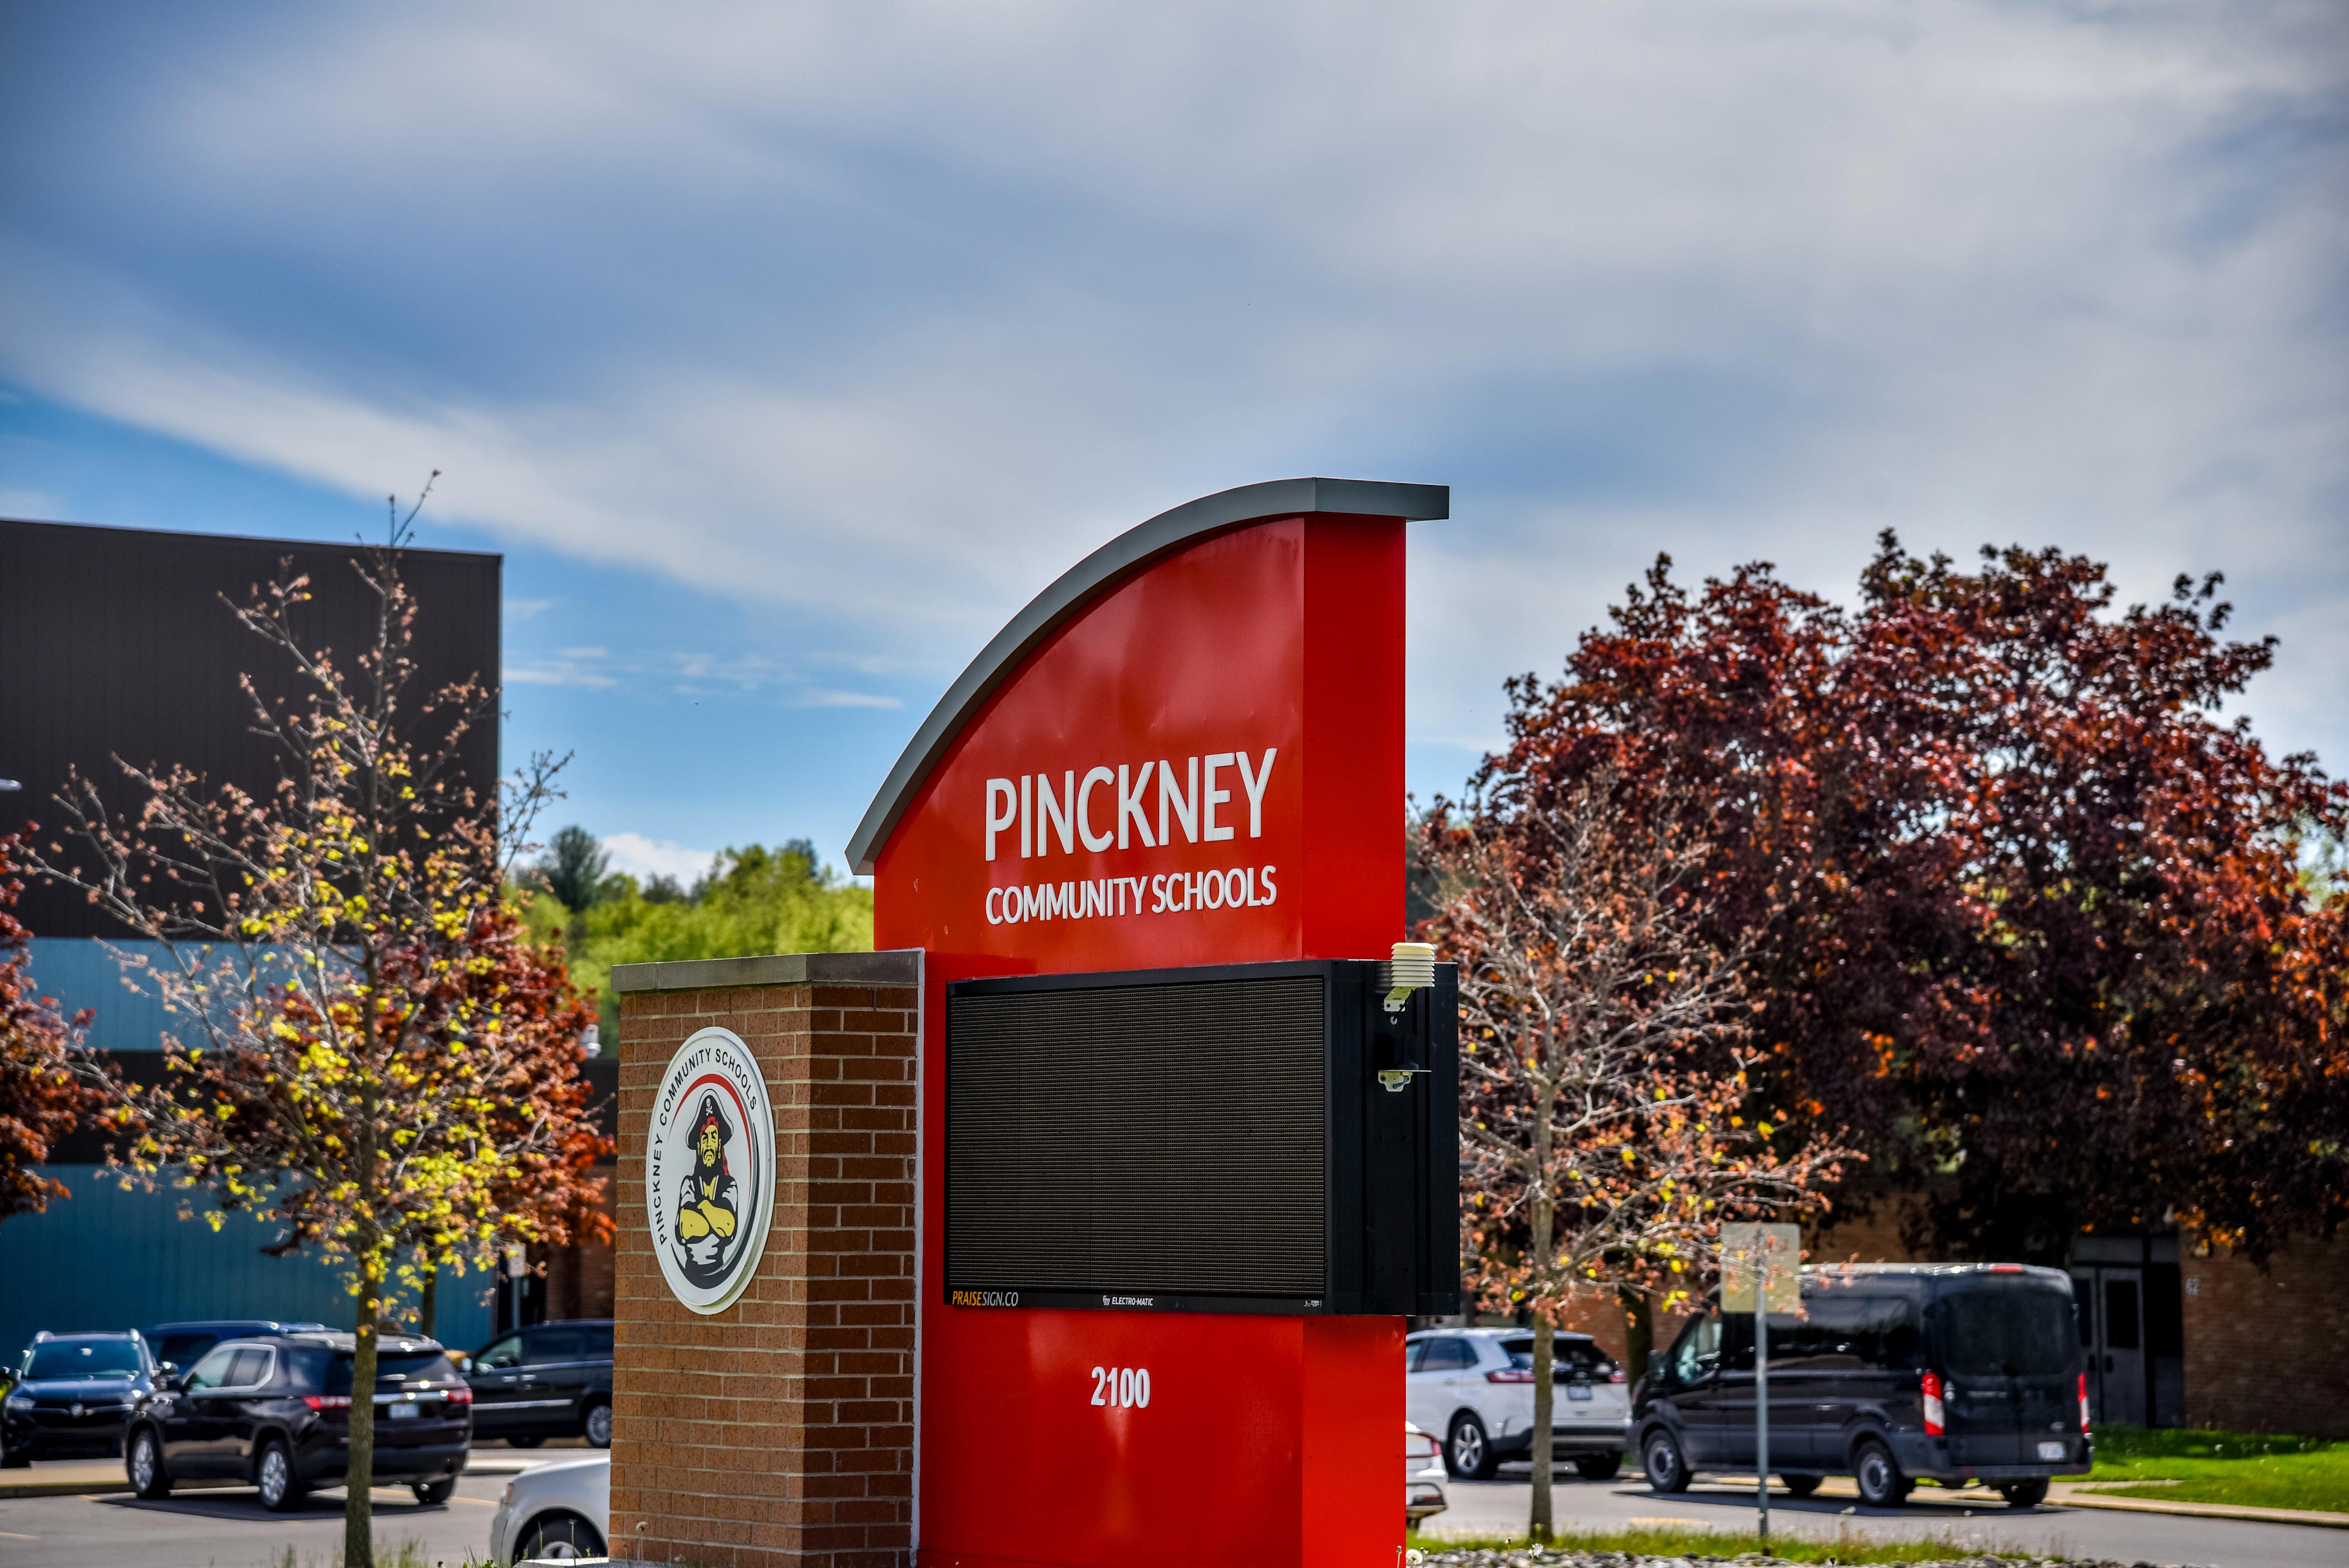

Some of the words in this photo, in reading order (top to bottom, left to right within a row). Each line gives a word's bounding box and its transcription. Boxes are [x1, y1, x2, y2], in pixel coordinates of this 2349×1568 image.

[985, 748, 1278, 861] PINCKNEY
[985, 876, 1149, 925] COMMUNITY
[1151, 865, 1278, 914] SCHOOLS
[652, 1133, 664, 1246] PINCKNEY
[659, 1048, 711, 1127] COMMUNITY
[715, 1048, 757, 1110] SCHOOLS
[952, 1290, 1019, 1306] PRAISESIGN.CO
[1112, 1296, 1154, 1306] ELECTRO-MATIC
[1091, 1366, 1150, 1409] 2100
